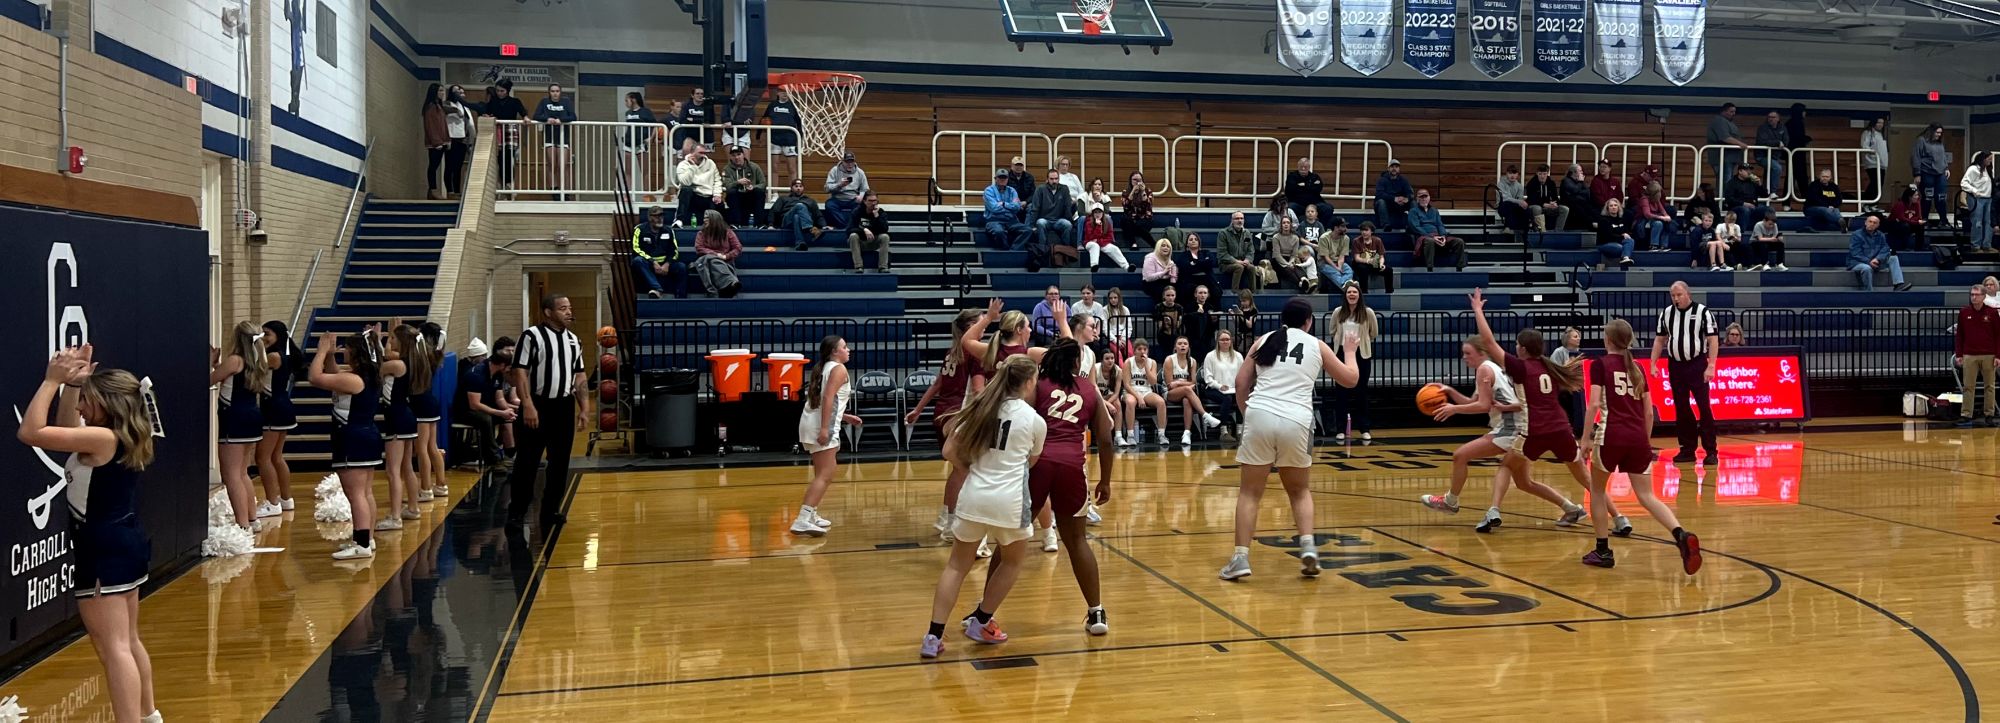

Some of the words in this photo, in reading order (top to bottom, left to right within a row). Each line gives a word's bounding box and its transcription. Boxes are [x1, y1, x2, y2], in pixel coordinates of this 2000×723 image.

[1281, 10, 1329, 26] 2019
[1341, 10, 1393, 26] 2022-23
[1405, 12, 1456, 29] 2022-23
[1472, 15, 1518, 32] 2015
[1536, 17, 1585, 33] 2021-22
[1597, 22, 1640, 38] 2020-21
[1656, 24, 1703, 39] 2021-22
[1407, 43, 1428, 51] CLASS
[1472, 45, 1485, 53] 4A
[1487, 46, 1517, 54] STATE
[1473, 53, 1517, 61] CHAMPIONS
[1306, 226, 1320, 238] 5K
[1717, 367, 1760, 379] neighbor,
[862, 376, 891, 387] CAVS
[1539, 373, 1553, 394] 0
[1718, 380, 1726, 389] is
[1728, 379, 1756, 389] there.
[1047, 388, 1084, 424] 22
[1724, 396, 1772, 405] 276-728-2361
[11, 531, 67, 577] CARROLL
[1252, 533, 1541, 615] CAVS
[27, 572, 58, 611] HIGH
